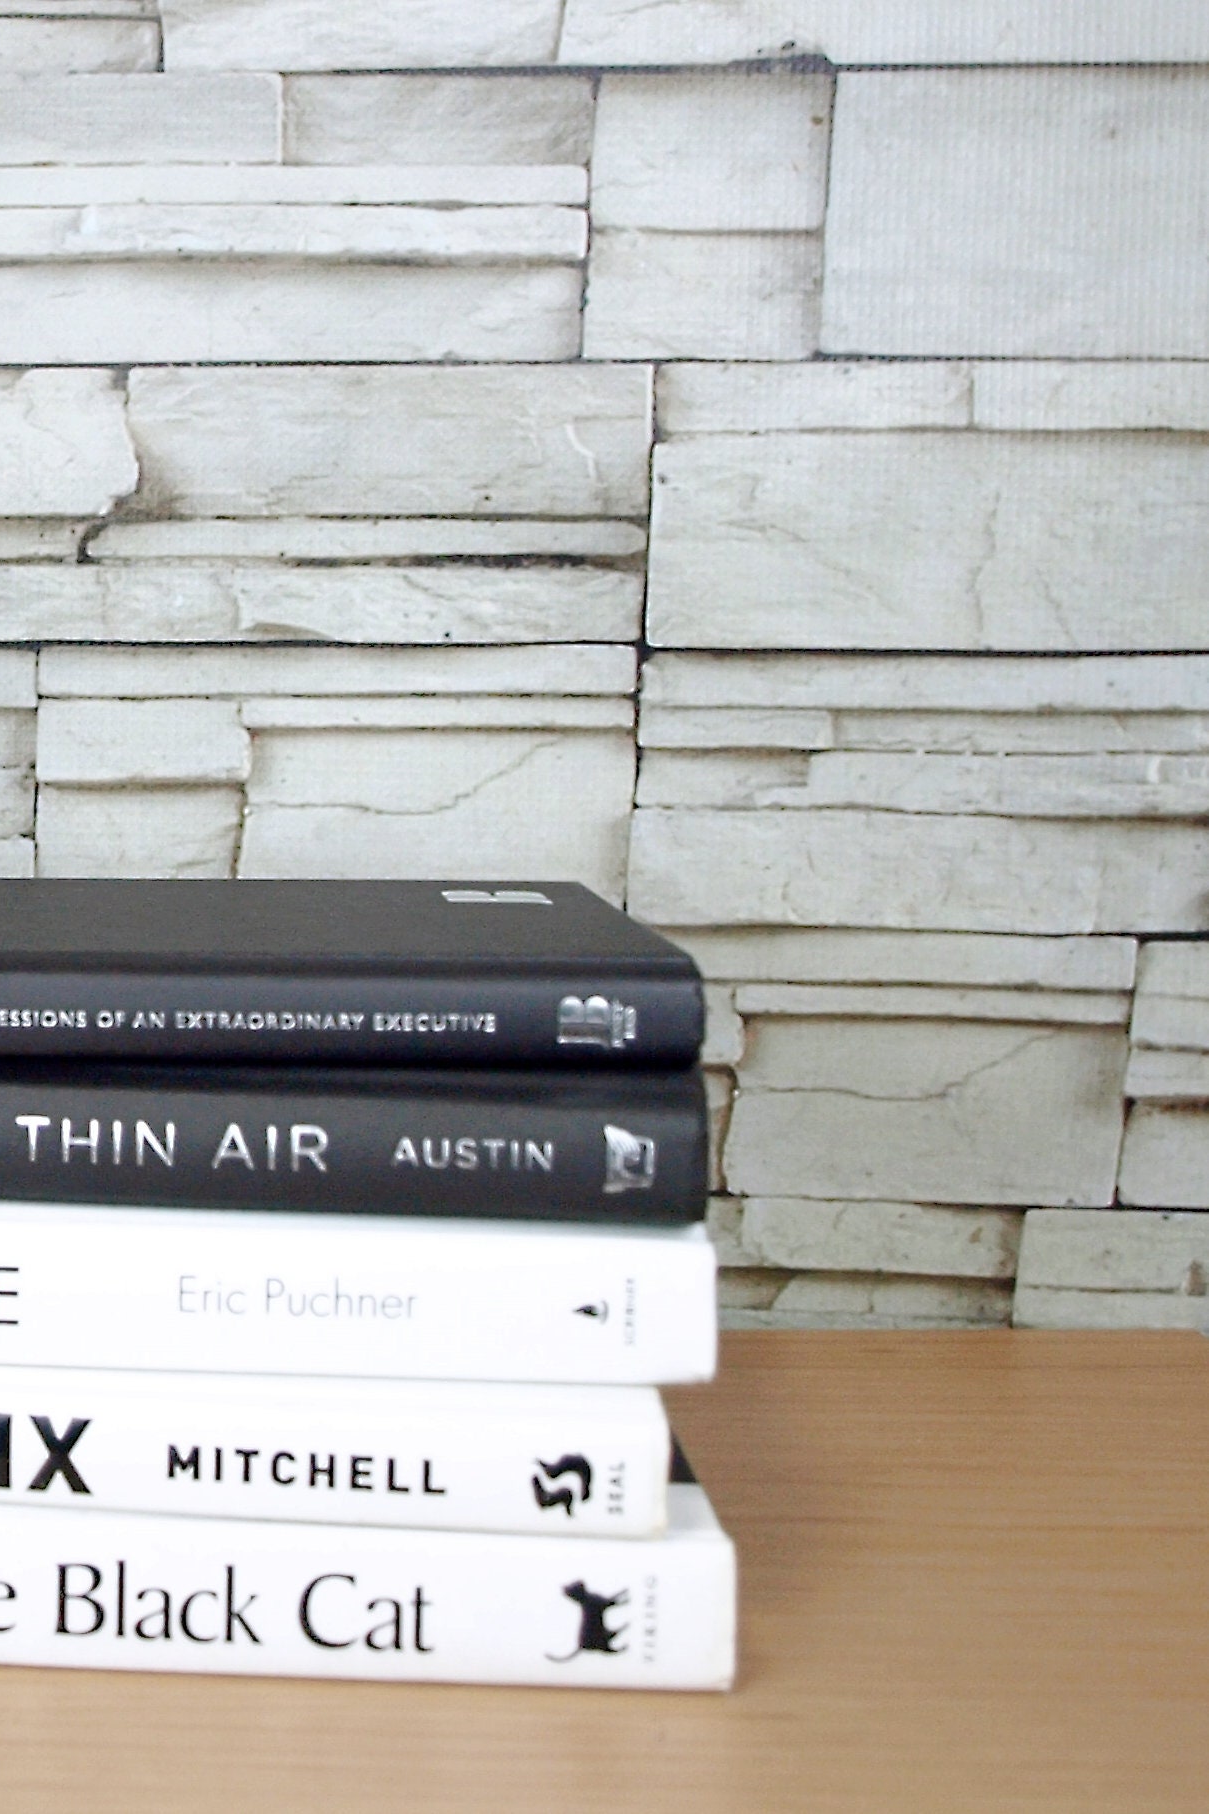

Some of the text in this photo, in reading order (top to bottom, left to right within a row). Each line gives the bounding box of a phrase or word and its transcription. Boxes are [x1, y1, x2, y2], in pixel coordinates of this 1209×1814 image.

[96, 1010, 126, 1029] OF
[132, 1011, 166, 1029] AN
[175, 1011, 365, 1031] EXTRAORDINARY
[373, 1012, 496, 1034] EXECUTIVE
[14, 1114, 177, 1167] THIN
[213, 1122, 329, 1171] AIR
[394, 1136, 554, 1170] AUSTIN
[177, 1274, 420, 1320] Eric Puchner
[167, 1444, 446, 1496] MITCHELL
[606, 1461, 628, 1517] SEAL
[55, 1560, 261, 1645] Black
[297, 1573, 433, 1654] Cat
[641, 1575, 660, 1666] VIKING
